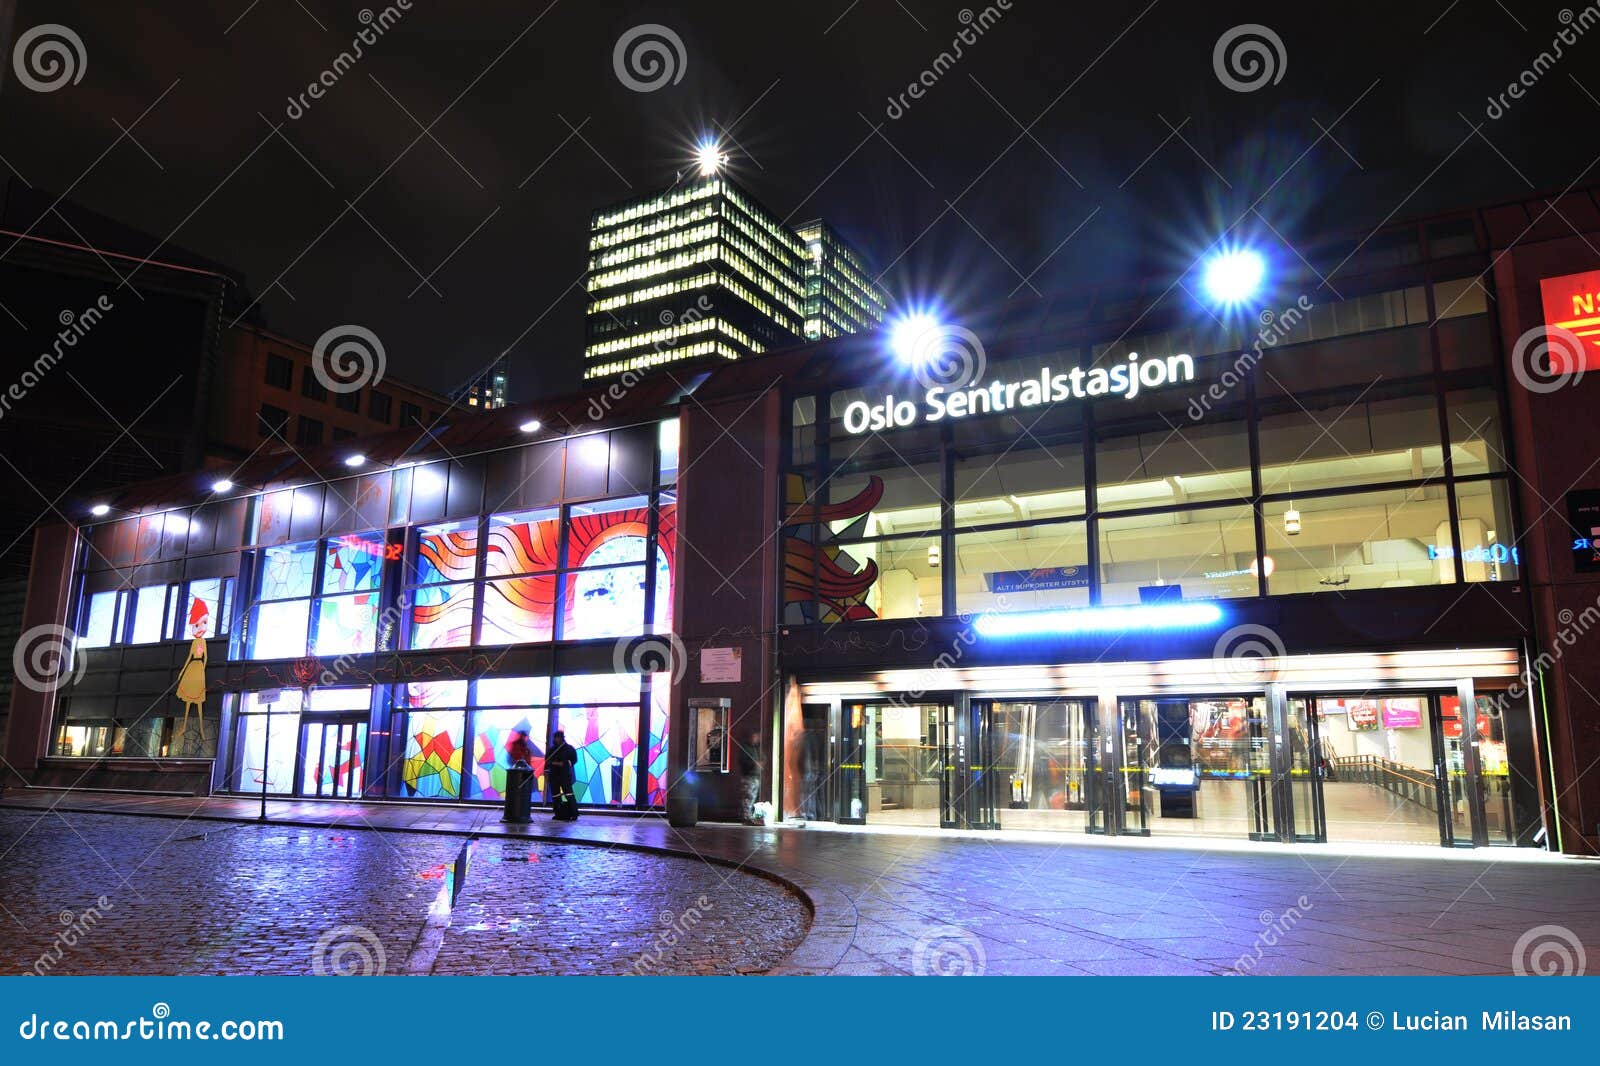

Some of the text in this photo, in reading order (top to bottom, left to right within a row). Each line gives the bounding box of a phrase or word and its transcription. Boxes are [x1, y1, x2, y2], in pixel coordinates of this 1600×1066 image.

[1572, 293, 1600, 316] N
[844, 352, 1194, 434] Oslo Sentralstasjon
